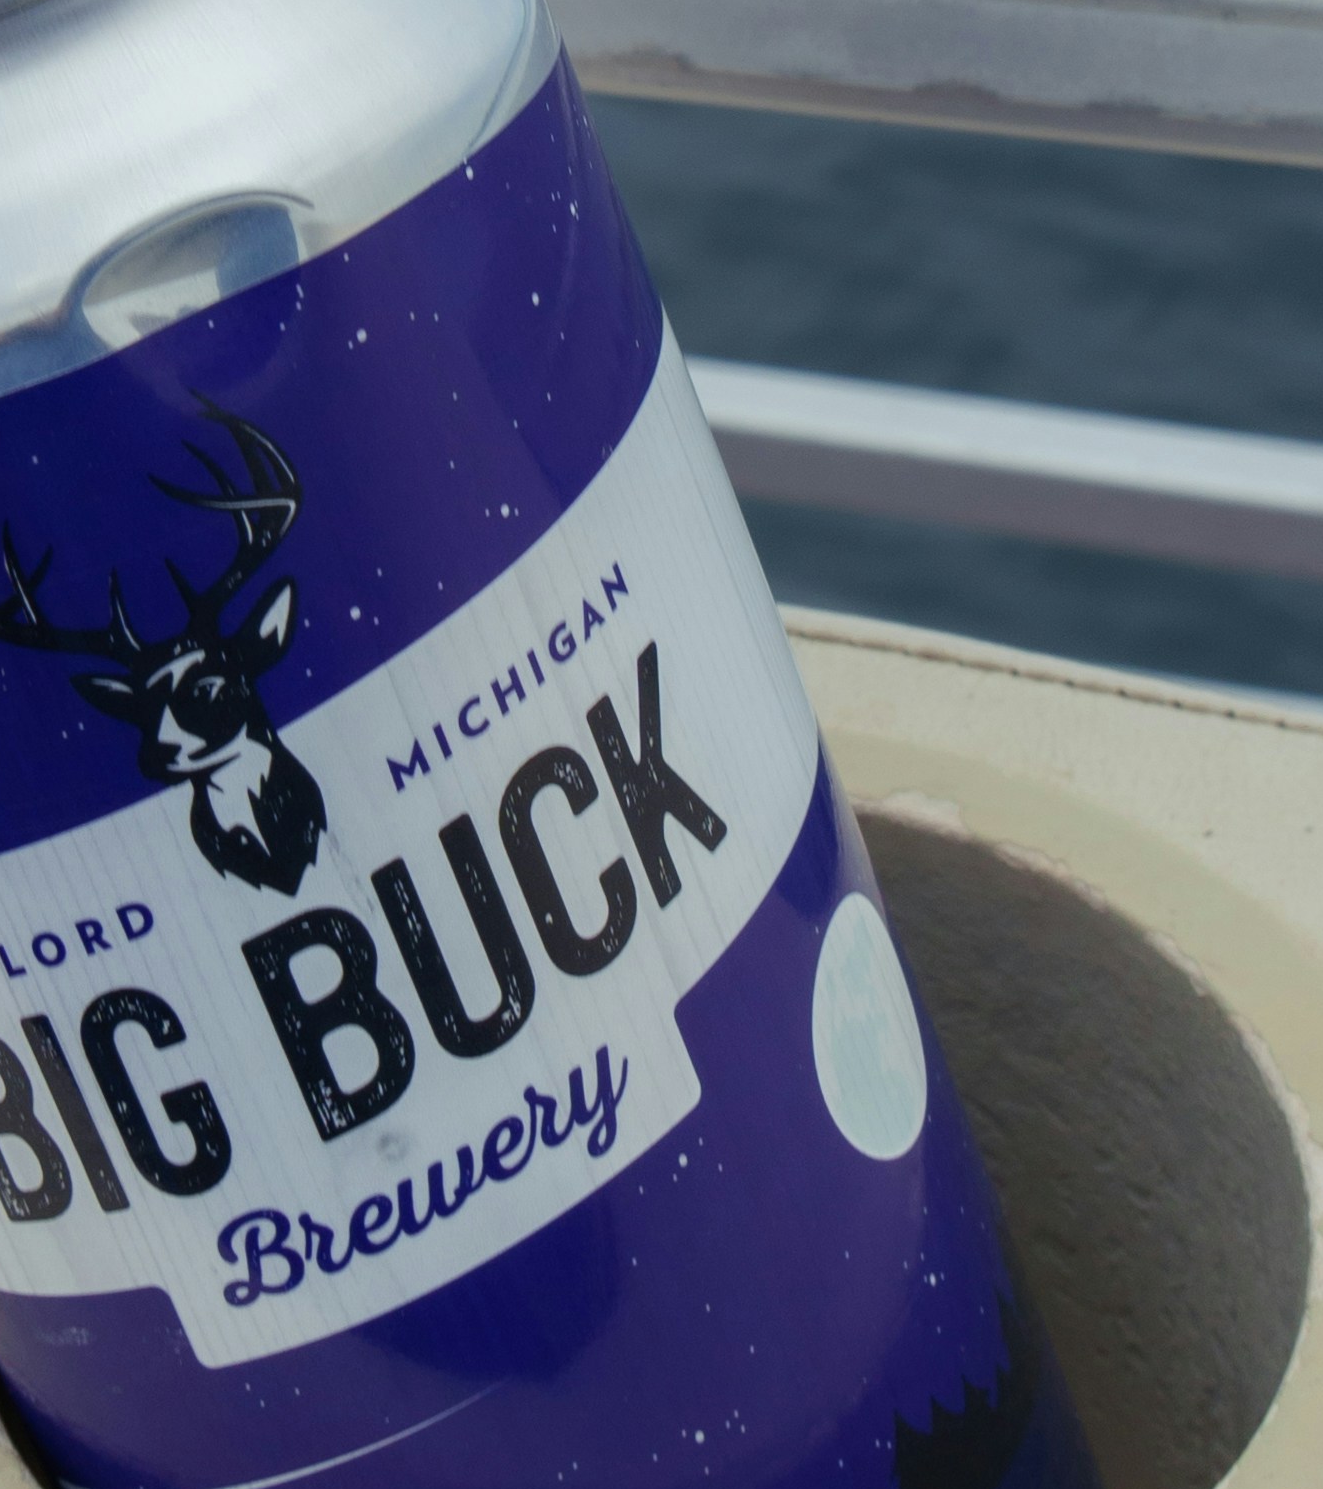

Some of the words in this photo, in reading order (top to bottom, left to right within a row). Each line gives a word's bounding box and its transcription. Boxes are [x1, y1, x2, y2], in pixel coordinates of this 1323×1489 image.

[385, 561, 631, 793] MICHIGAN
[240, 639, 729, 1143] BUCK
[217, 1044, 630, 1308] Brewery
